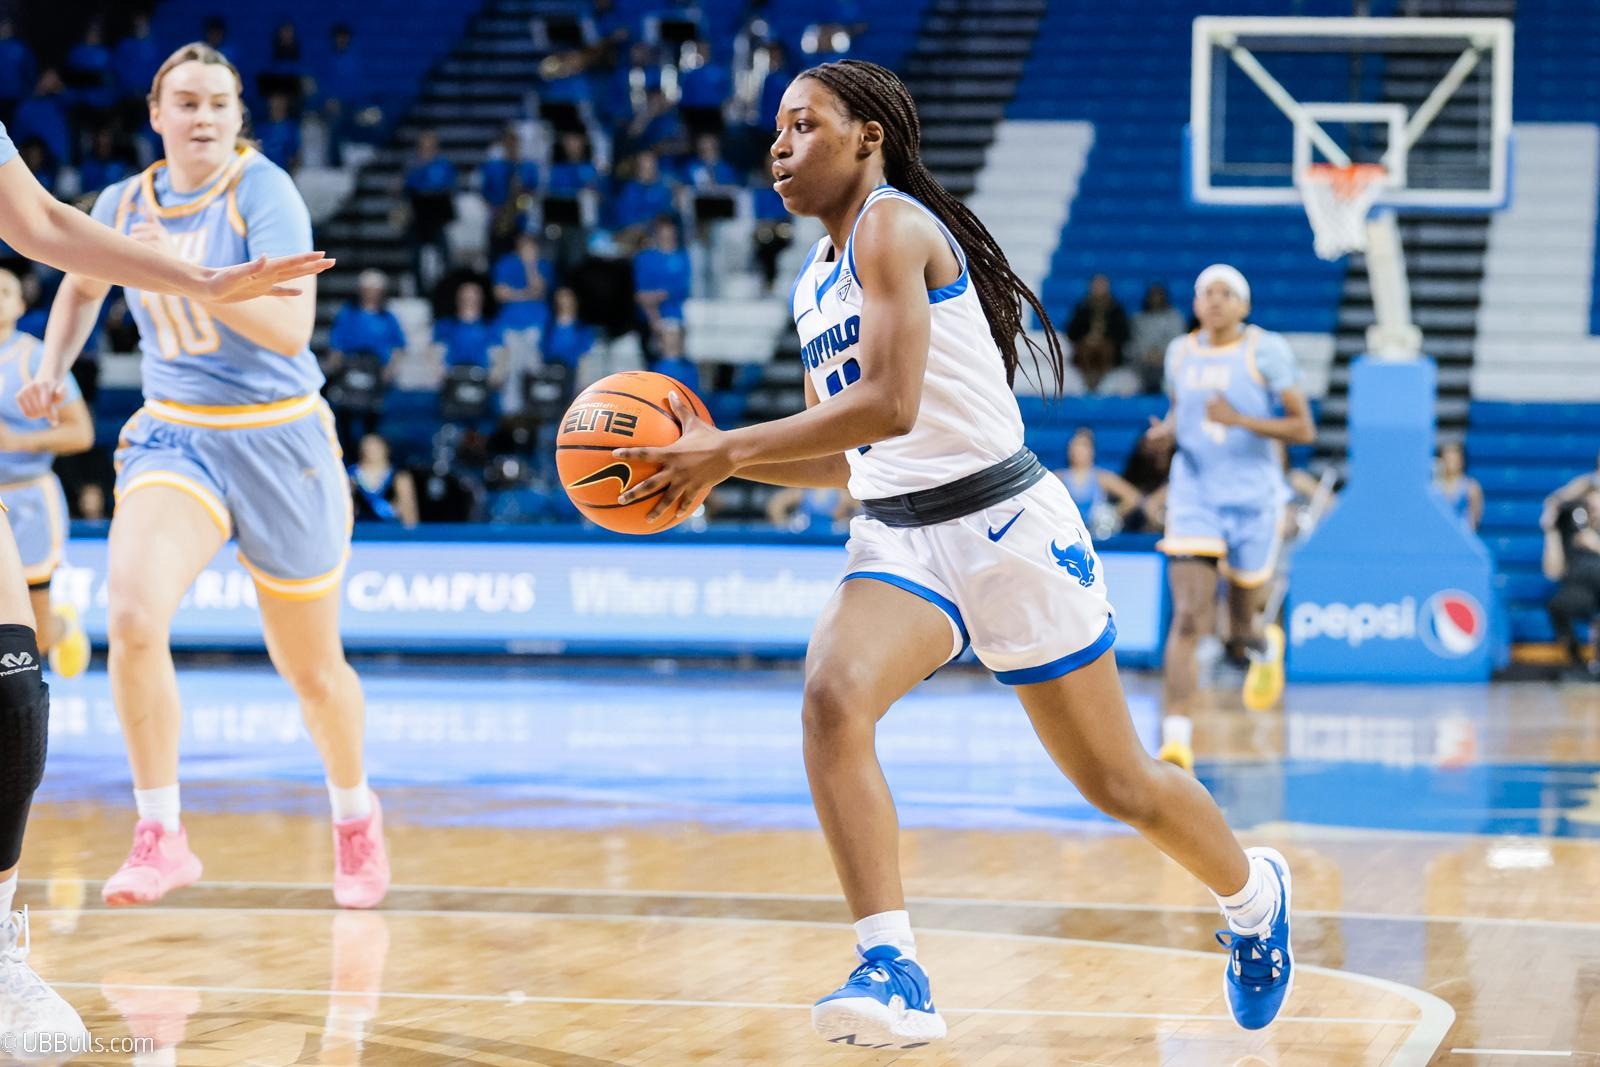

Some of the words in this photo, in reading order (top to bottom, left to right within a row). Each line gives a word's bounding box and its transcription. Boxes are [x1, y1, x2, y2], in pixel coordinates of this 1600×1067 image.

[563, 408, 638, 437] ELITE
[348, 571, 535, 612] CAMPUS
[1292, 597, 1415, 646] pepsi
